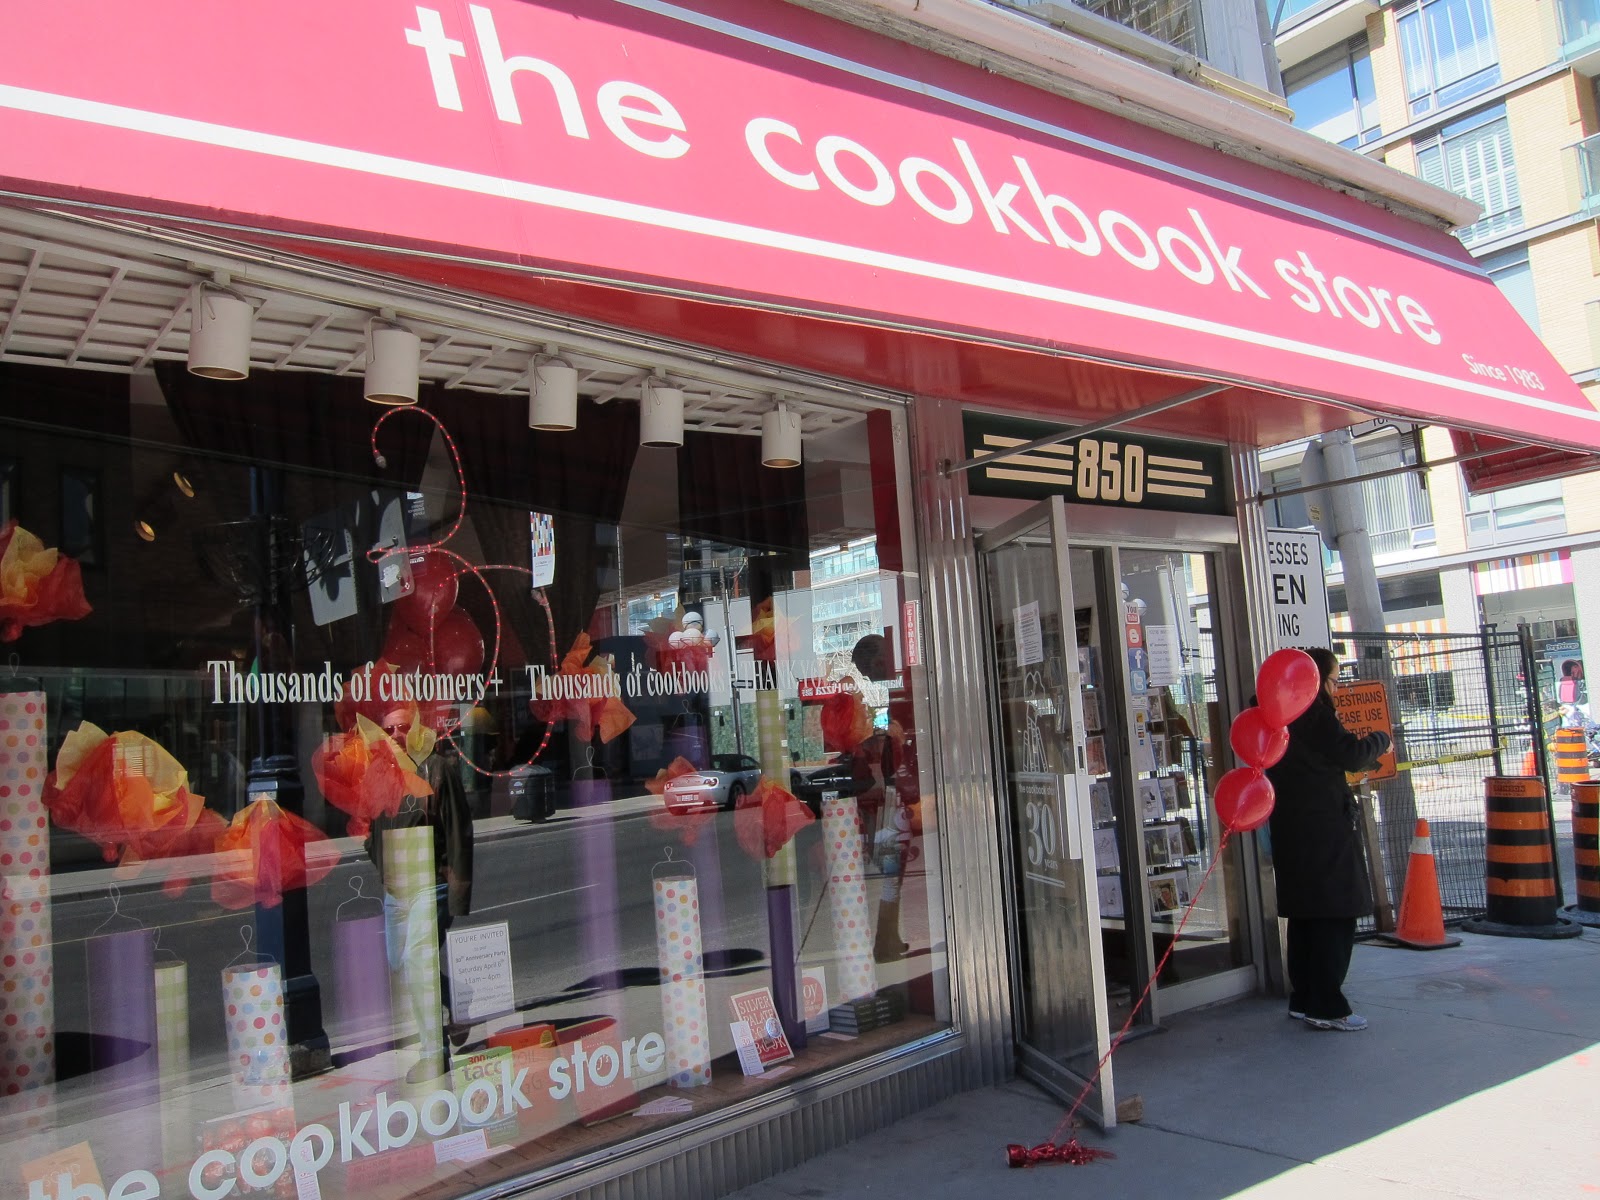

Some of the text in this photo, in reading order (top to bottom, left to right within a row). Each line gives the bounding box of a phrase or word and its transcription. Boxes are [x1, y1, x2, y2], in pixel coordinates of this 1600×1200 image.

[404, 3, 1442, 346] the cookbook store
[1461, 353, 1545, 391] Since 1983
[1077, 438, 1144, 503] 850
[1269, 541, 1309, 566] ESSES
[1272, 573, 1307, 605] EN
[1277, 612, 1300, 637] ING
[207, 660, 344, 704] Thousands
[350, 660, 374, 702] of
[378, 664, 486, 702] customers
[525, 662, 622, 701] Thousands
[626, 662, 643, 698] of
[740, 659, 797, 692] THANK
[1333, 690, 1383, 708] DESTRIANS
[1337, 707, 1383, 725] EASE USE
[454, 929, 504, 944] YOU'RE INVITED
[458, 966, 482, 975] Saturday
[483, 961, 497, 971] April
[464, 975, 481, 985] 11am
[487, 972, 501, 980] 4pm
[737, 995, 772, 1015] SILVER
[803, 984, 818, 1005] OY
[742, 1009, 775, 1027] PALATE
[468, 1054, 486, 1064] 300
[188, 1058, 534, 1200] cookbook
[548, 1031, 666, 1100] store
